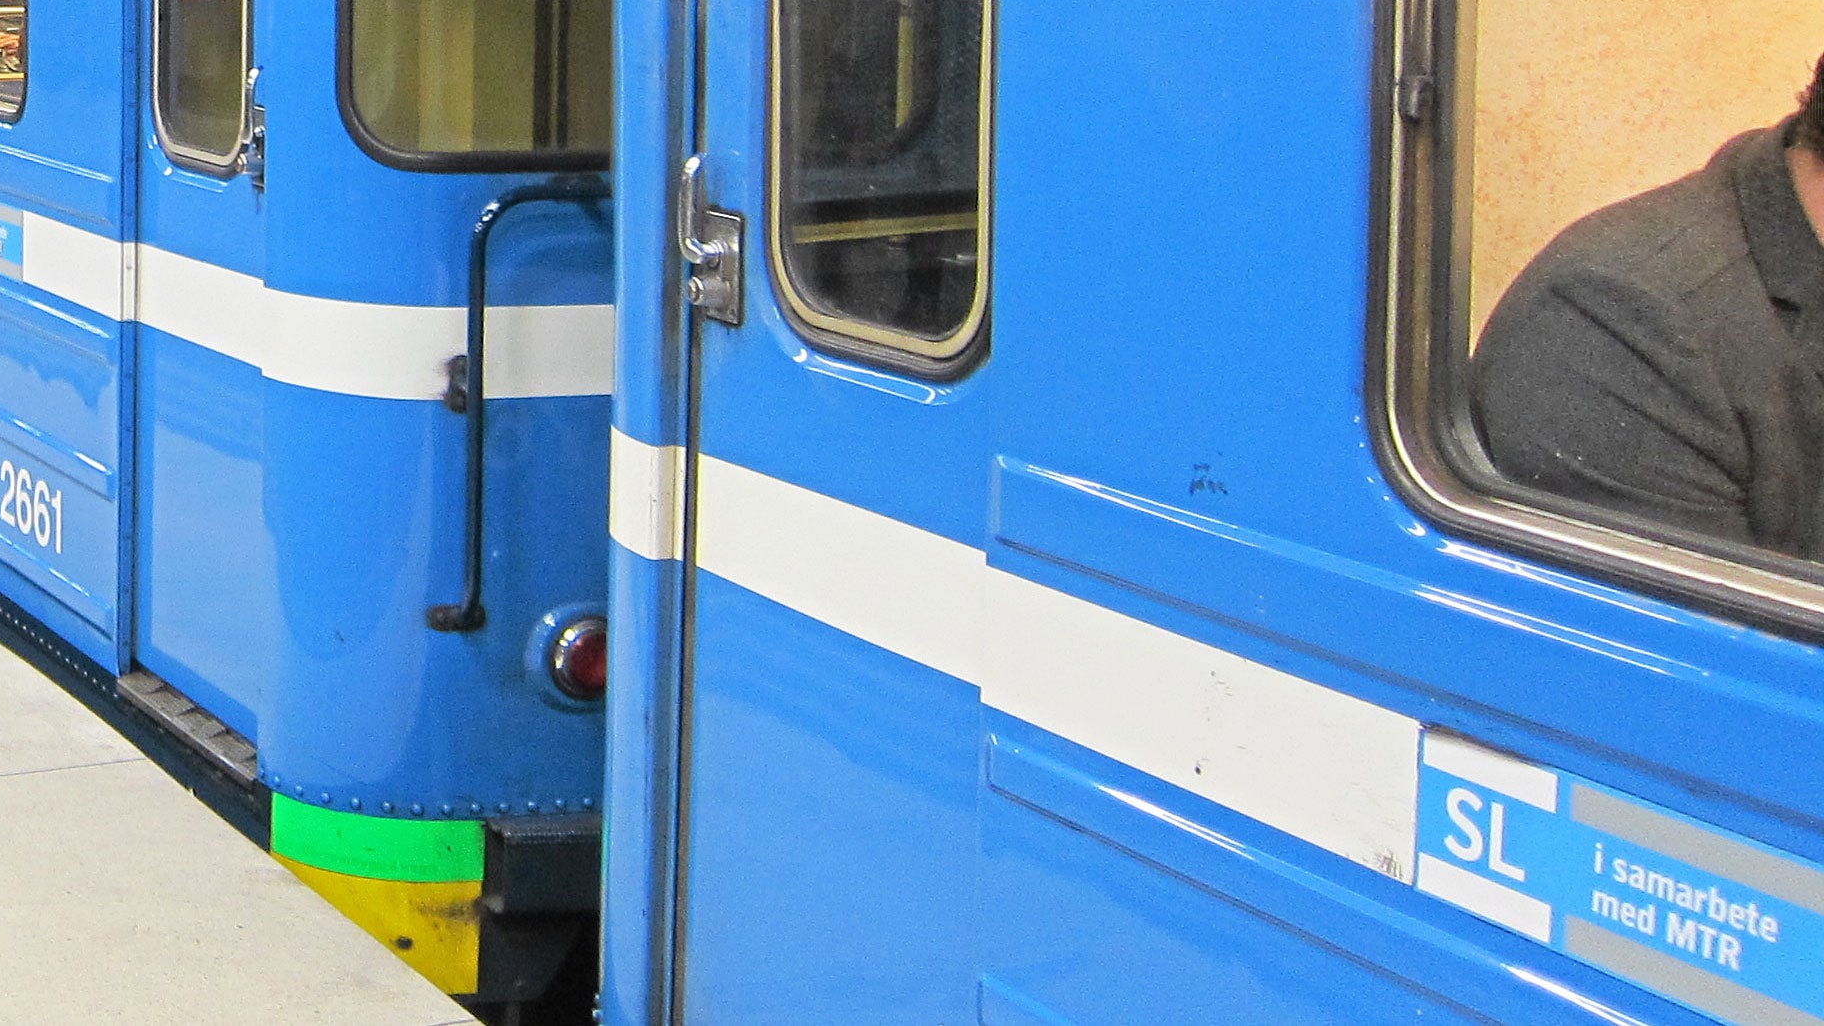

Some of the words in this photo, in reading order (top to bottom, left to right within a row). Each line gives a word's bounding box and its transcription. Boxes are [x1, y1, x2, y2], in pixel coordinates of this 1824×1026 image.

[0, 460, 62, 554] 2661
[1444, 787, 1526, 882] SL
[1591, 890, 1657, 936] med
[1666, 911, 1742, 972] MTR
[1594, 842, 1604, 874] i
[1612, 857, 1780, 943] samarbete
